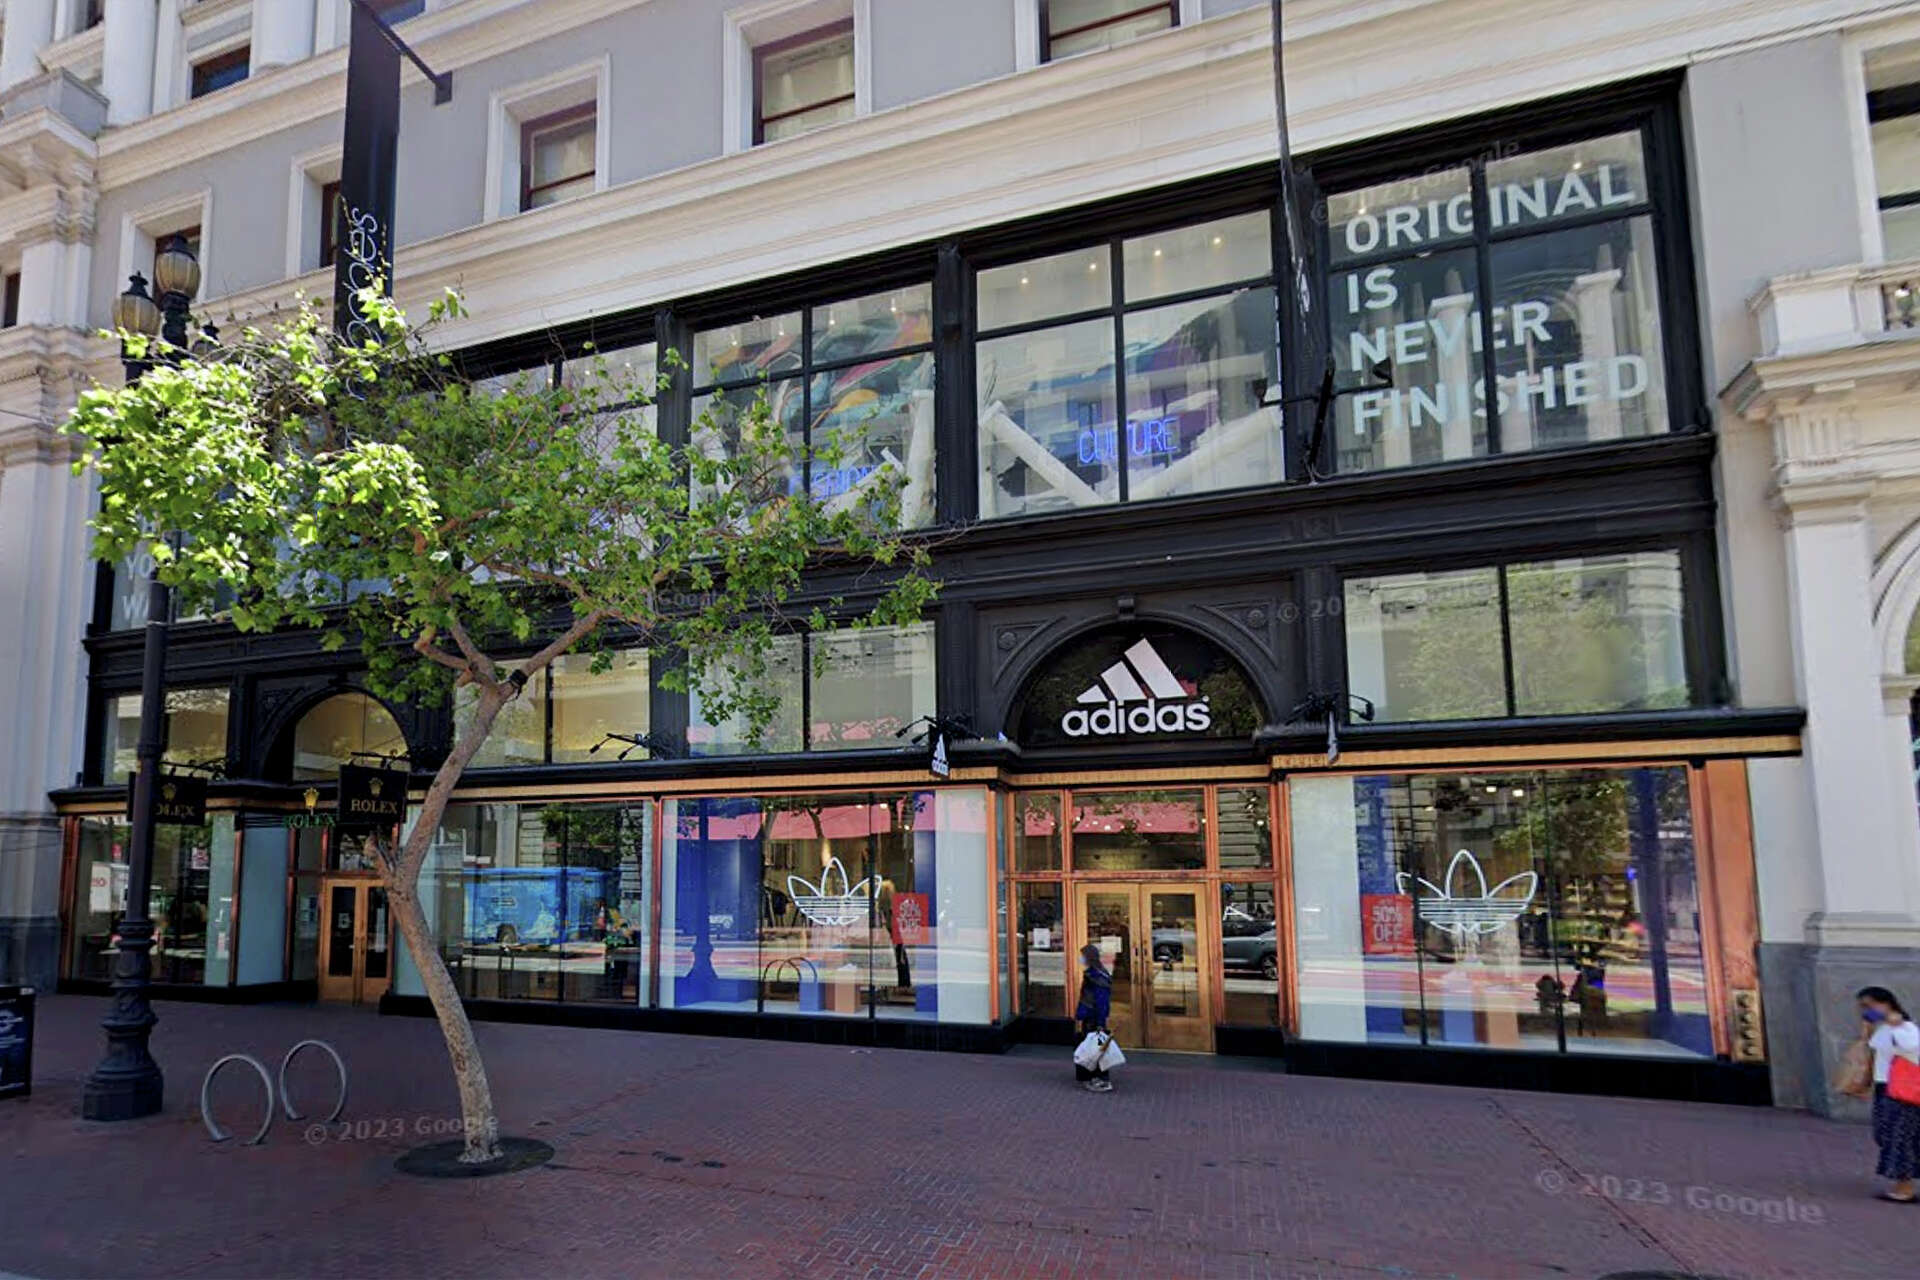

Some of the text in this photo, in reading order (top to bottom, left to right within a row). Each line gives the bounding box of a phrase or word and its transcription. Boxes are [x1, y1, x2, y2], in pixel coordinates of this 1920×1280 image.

[1345, 164, 1636, 253] ORIGINAL
[1347, 268, 1398, 314] IS
[1350, 300, 1552, 372] NEVER
[1352, 353, 1649, 435] FINISHED
[1080, 417, 1178, 464] CULURE
[1061, 698, 1211, 737] adidas
[350, 799, 398, 815] ROLEX
[1372, 905, 1403, 922] 50%
